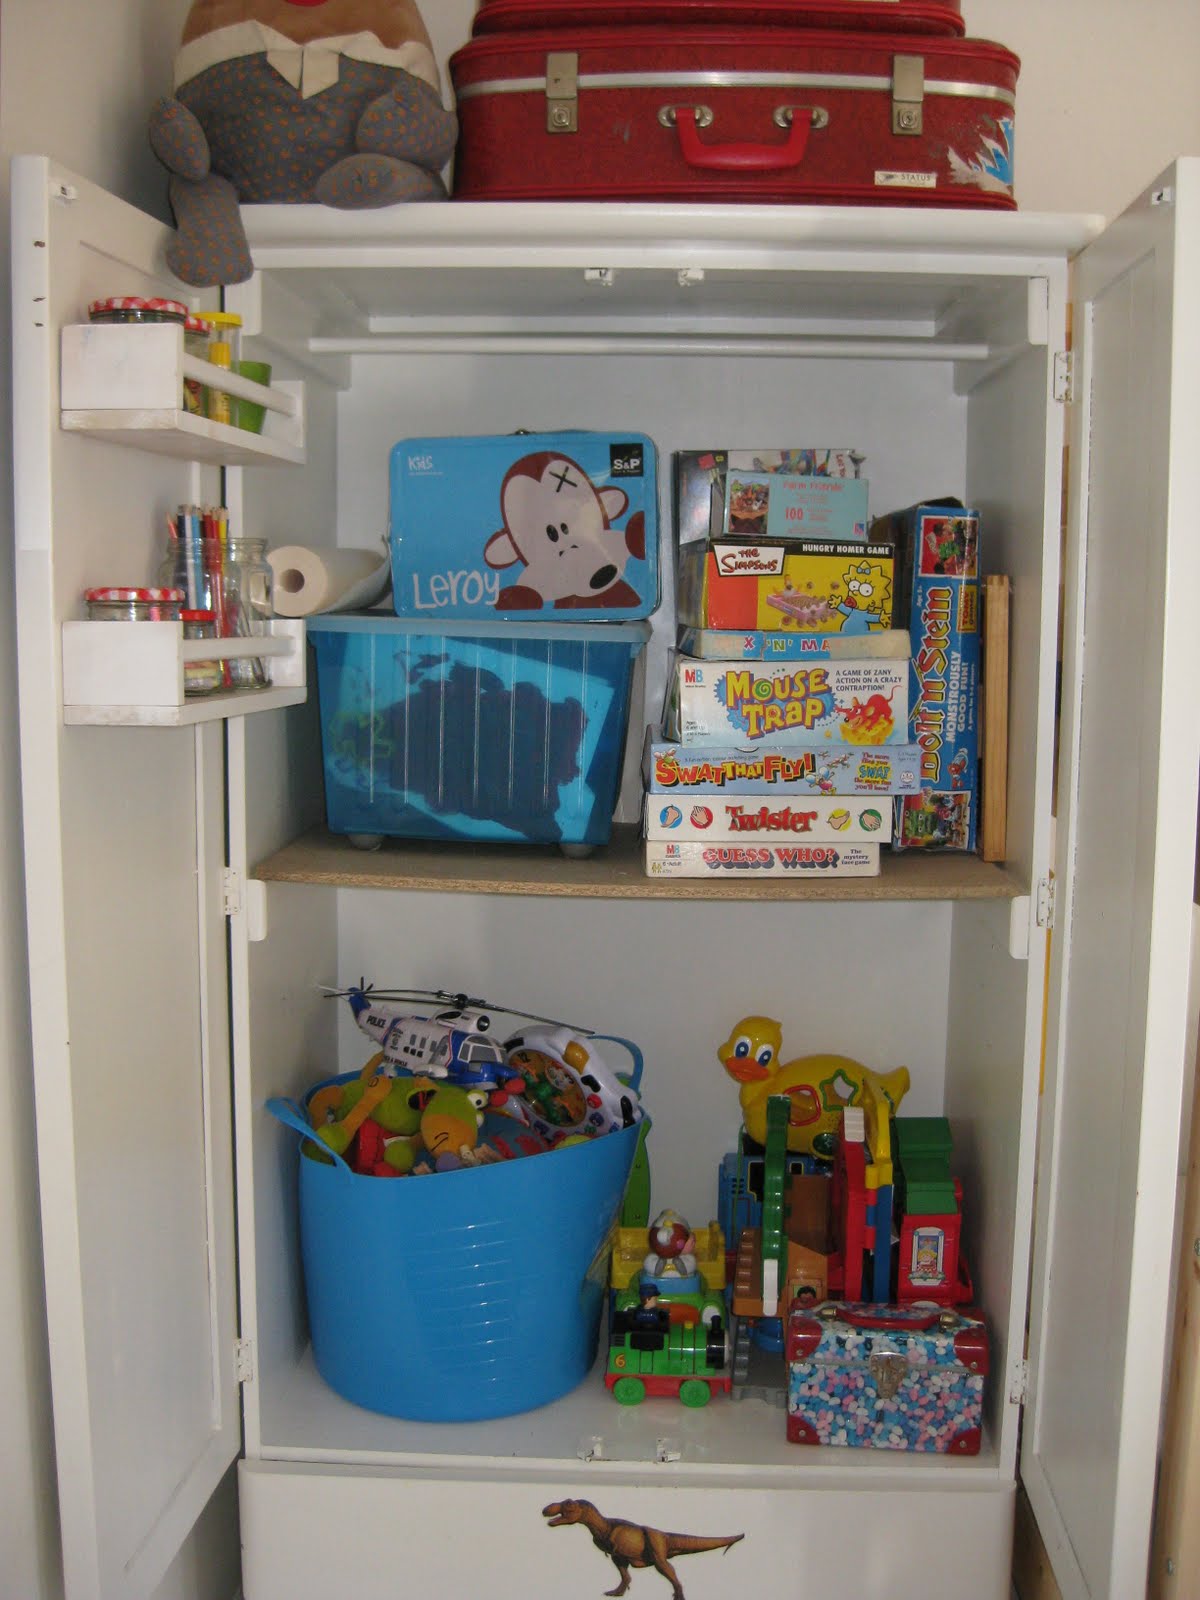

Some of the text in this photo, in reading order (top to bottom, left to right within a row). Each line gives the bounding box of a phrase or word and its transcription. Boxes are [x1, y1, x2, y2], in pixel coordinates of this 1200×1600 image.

[901, 173, 931, 181] STATUS
[613, 458, 640, 470] S&P
[785, 507, 804, 520] 100
[802, 543, 889, 555] HUNGRY HOMER GAME
[412, 570, 500, 609] Leroy
[918, 586, 953, 676] Stein
[685, 669, 703, 683] MB
[726, 668, 829, 709] MOUSE
[945, 651, 960, 743] MONSTROUSLY
[957, 662, 969, 732] GOOD FUN!
[742, 697, 826, 739] TRAP
[656, 753, 816, 786] SWAT THAT FLY!
[859, 765, 890, 779] SWAT
[725, 805, 818, 833] Twister
[666, 844, 680, 854] MB
[703, 848, 838, 867] GUESS WHO?
[366, 1015, 387, 1028] POLICE
[614, 1353, 625, 1368] 6
